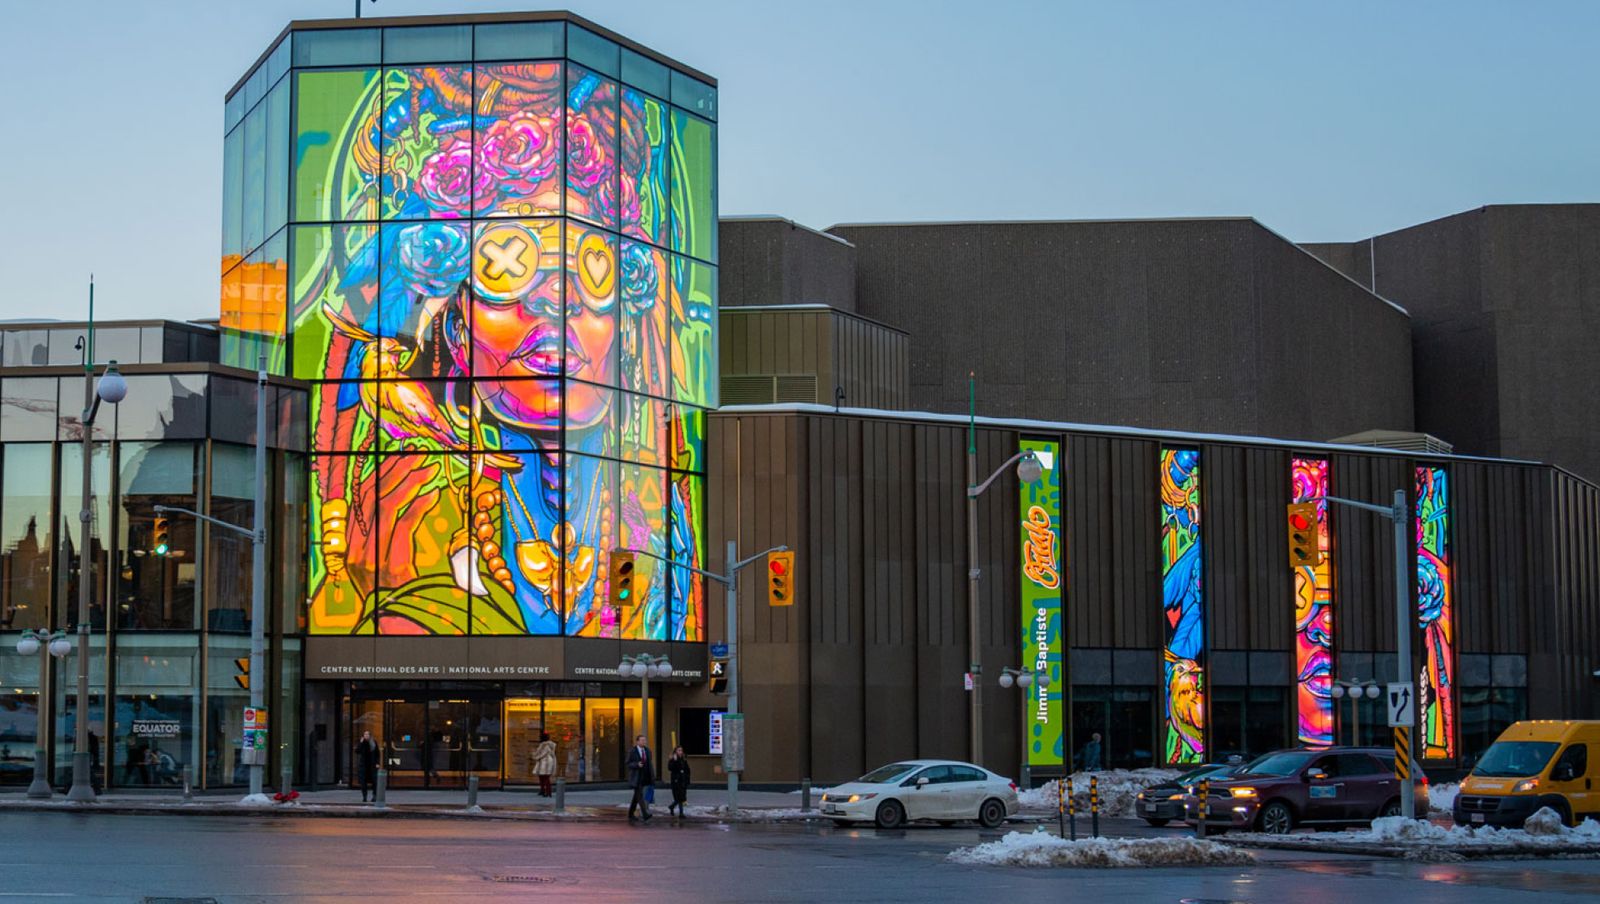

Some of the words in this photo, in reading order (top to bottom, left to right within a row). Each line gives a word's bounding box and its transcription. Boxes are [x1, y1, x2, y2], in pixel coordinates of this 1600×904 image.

[1035, 607, 1050, 670] Baptiste
[448, 666, 491, 674] NATIONAL
[493, 666, 515, 674] ARTS
[517, 666, 550, 674] CENTRE
[574, 667, 595, 675] CENTRE
[1036, 684, 1048, 724] Jimm
[132, 724, 180, 733] EQUATOR
